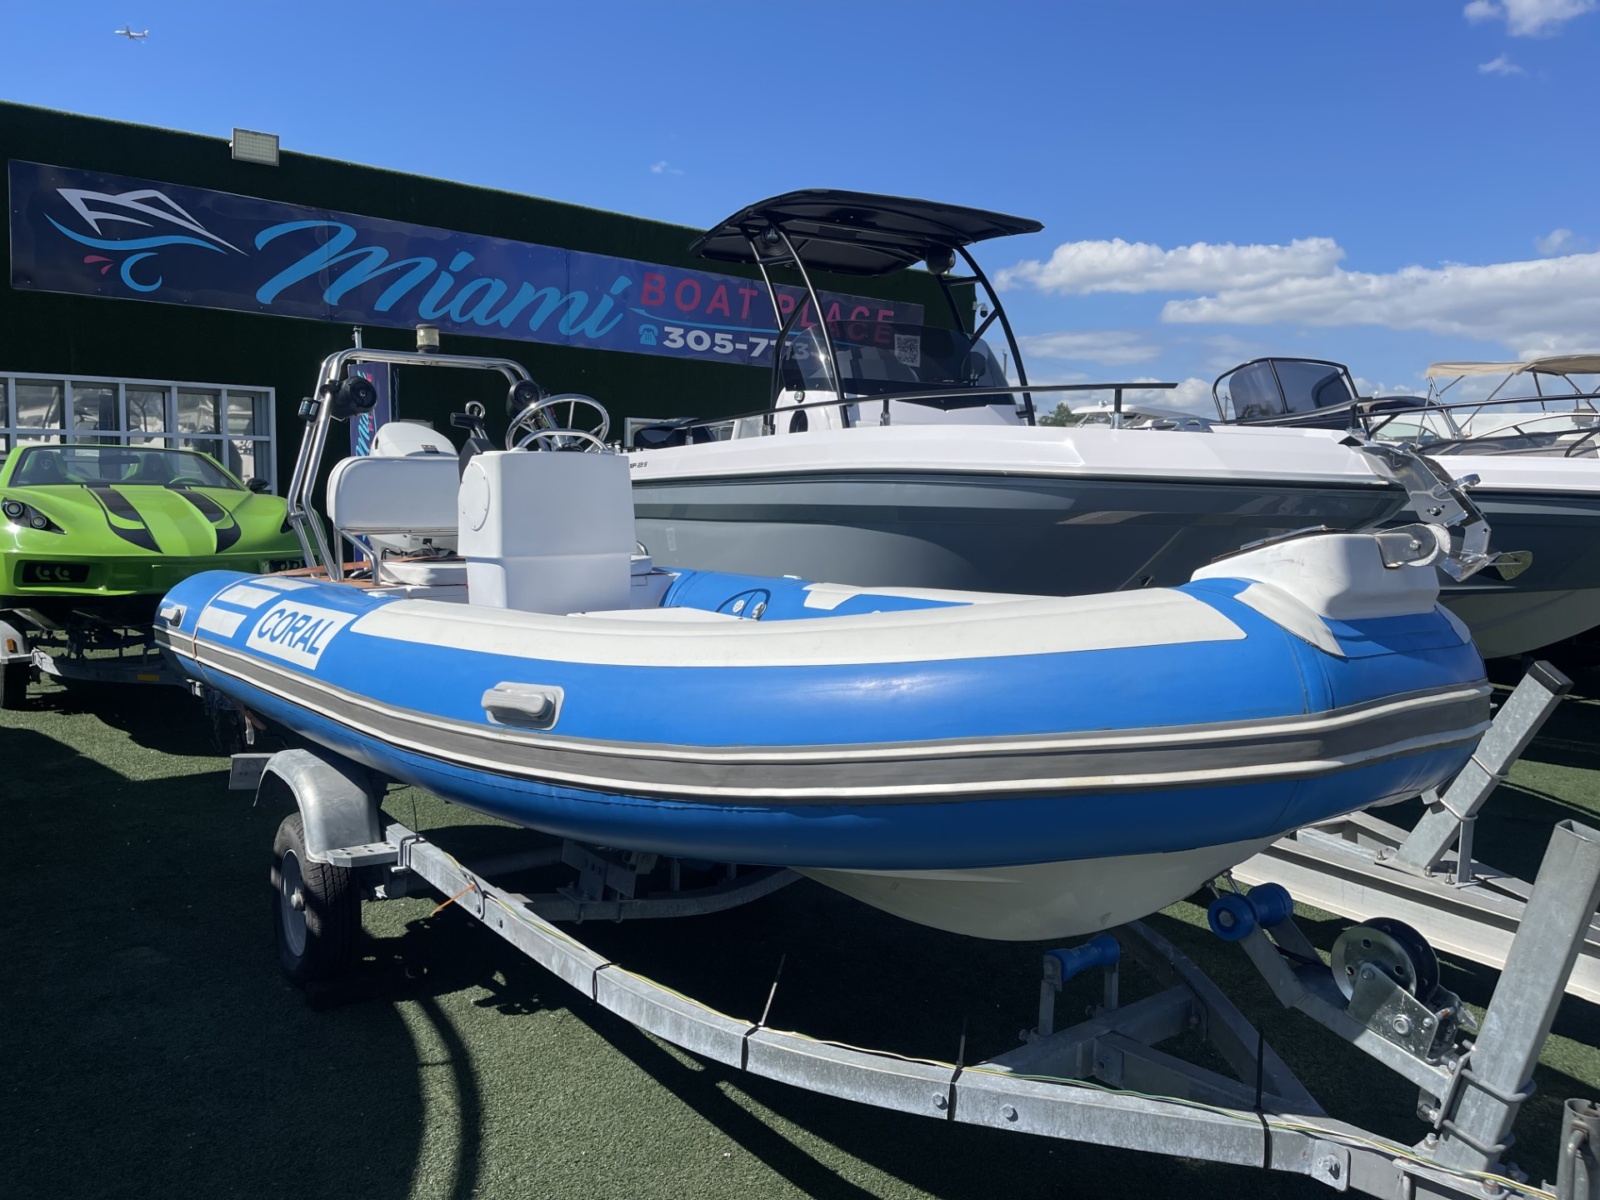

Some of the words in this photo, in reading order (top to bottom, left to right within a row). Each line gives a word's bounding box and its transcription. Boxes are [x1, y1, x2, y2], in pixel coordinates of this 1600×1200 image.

[254, 219, 633, 339] Miami
[641, 272, 758, 319] BOAT
[774, 294, 894, 343] PLACE
[257, 608, 335, 656] CORAL
